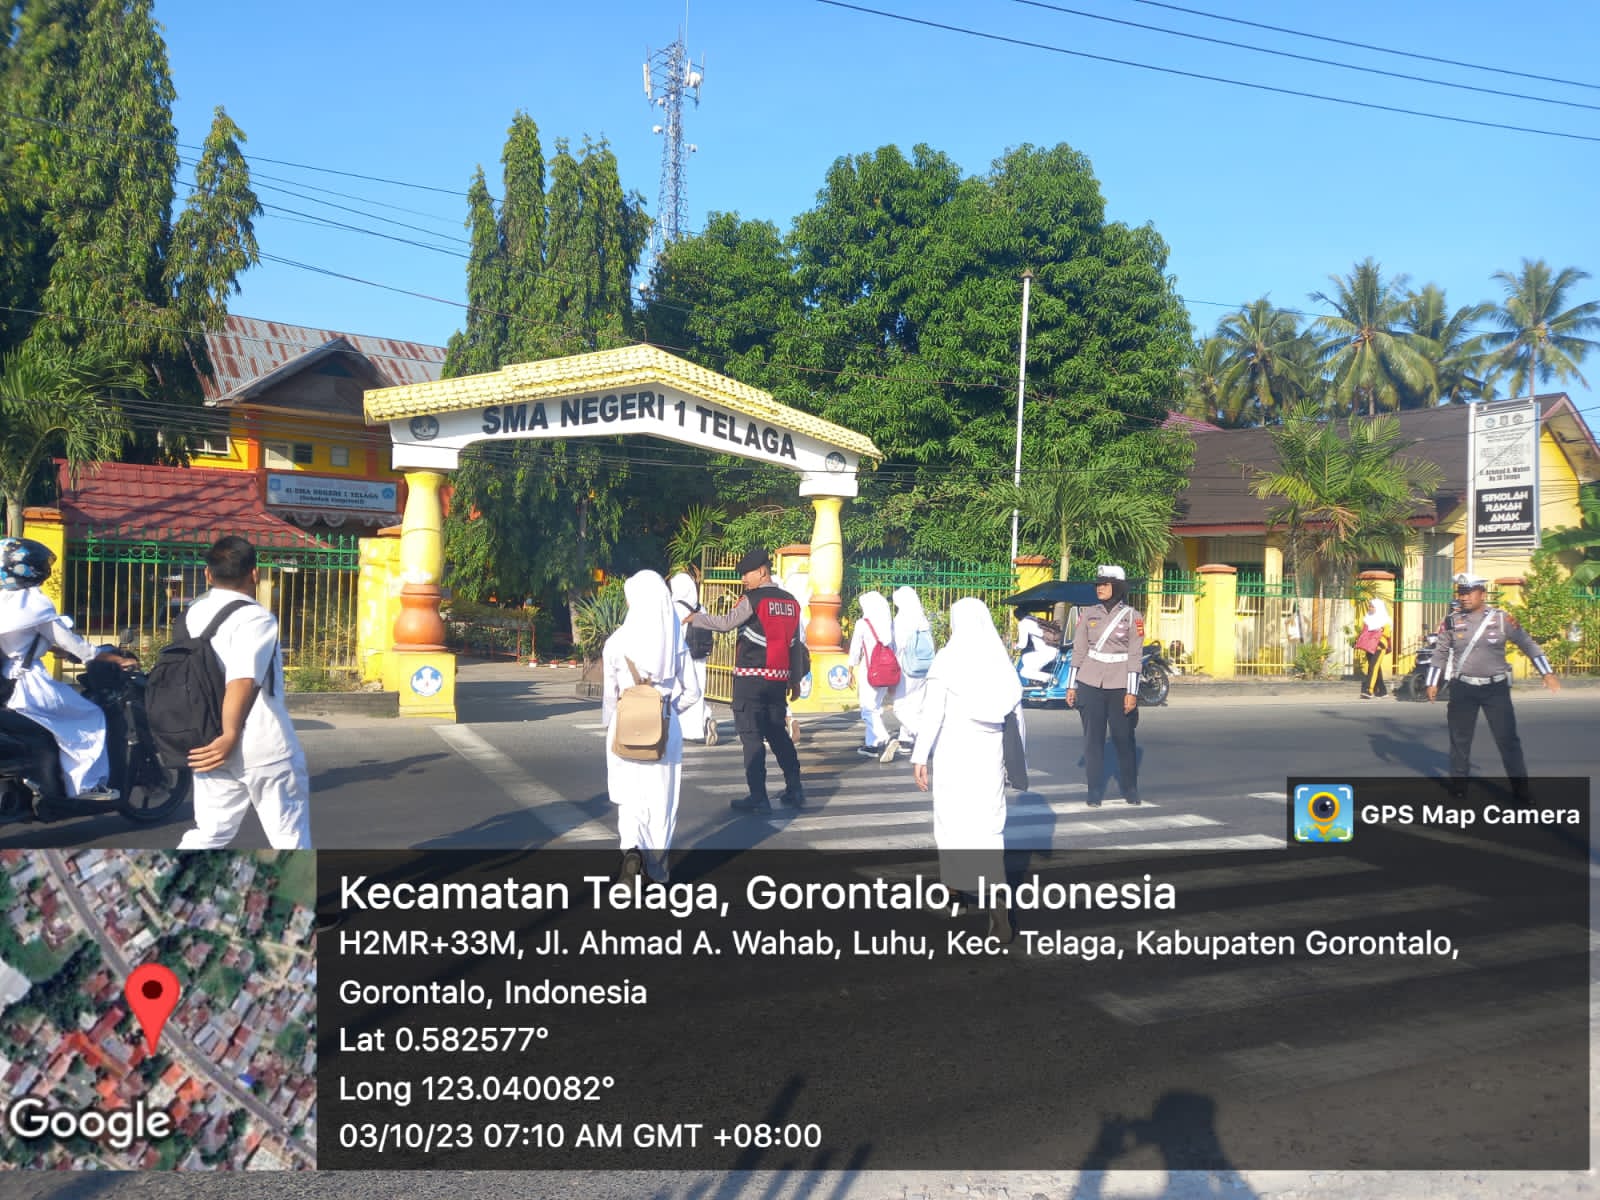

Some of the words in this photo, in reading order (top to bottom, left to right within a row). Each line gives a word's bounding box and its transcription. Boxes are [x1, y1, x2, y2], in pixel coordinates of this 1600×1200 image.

[482, 402, 549, 435] SMA
[560, 390, 665, 428] NEGERI
[674, 401, 686, 427] 1
[696, 405, 797, 460] TELAGA
[1481, 490, 1529, 502] SEKOLAH
[1485, 501, 1522, 512] RAMAH
[1489, 512, 1520, 522] ANAK
[1478, 522, 1532, 533] INSPIRATIF
[768, 601, 796, 616] POLISI
